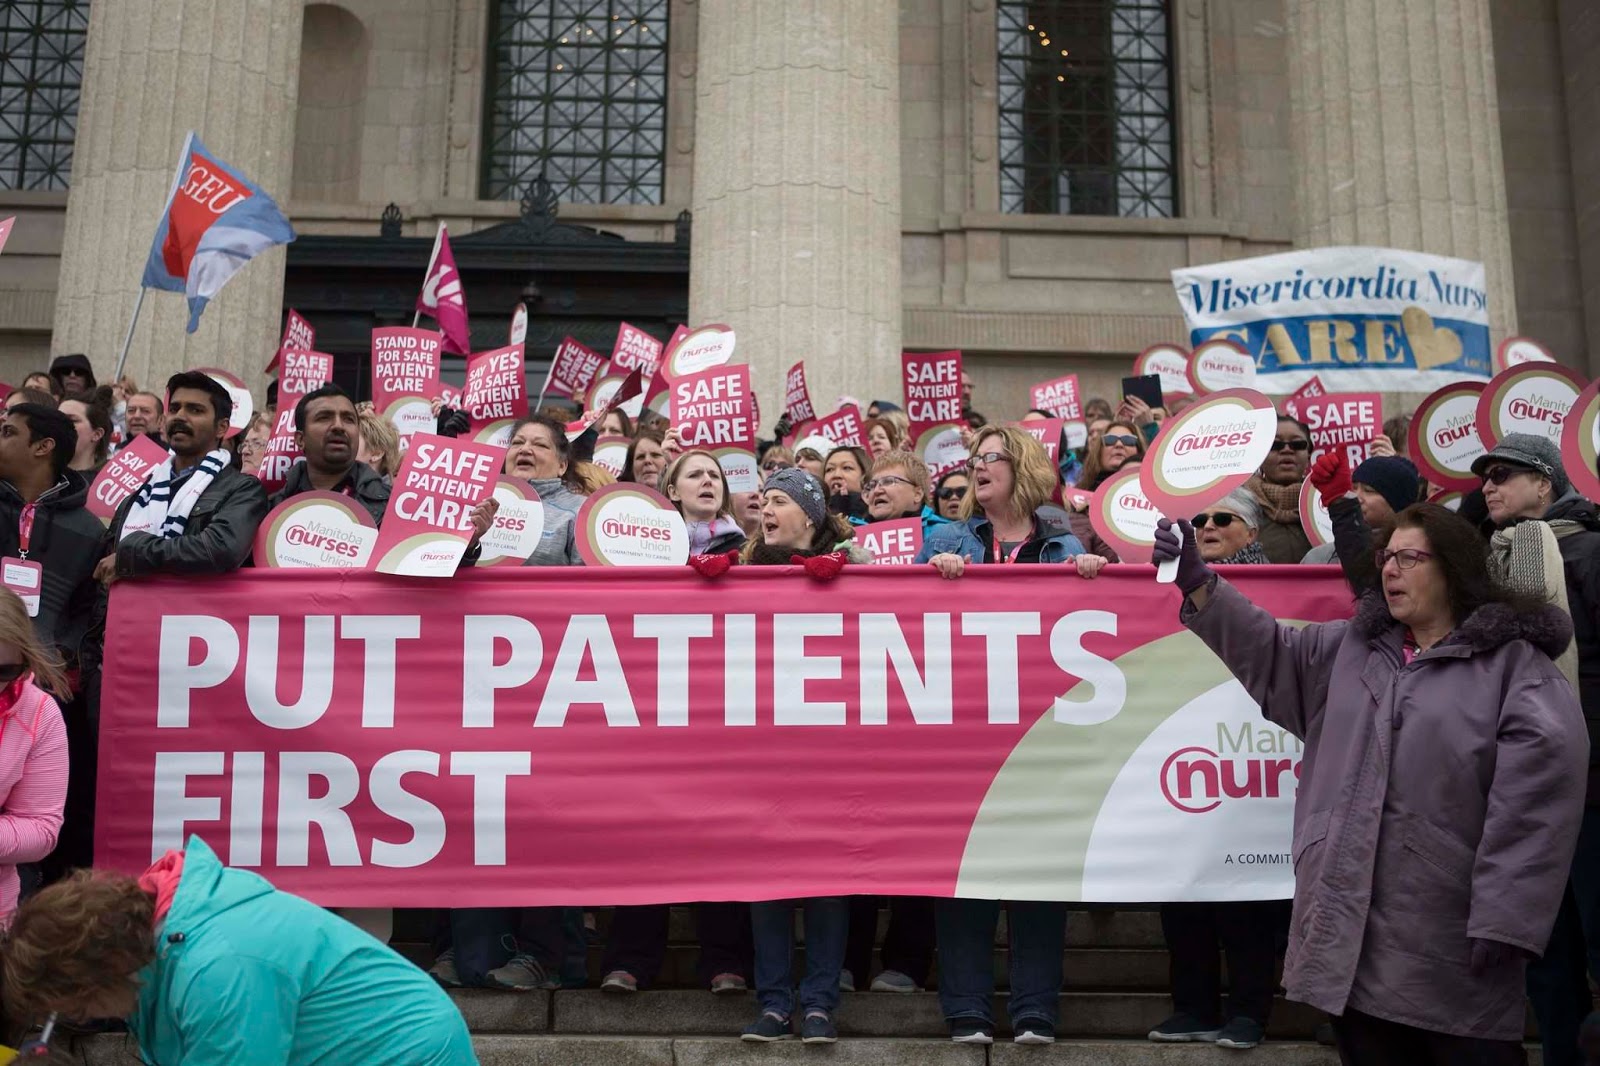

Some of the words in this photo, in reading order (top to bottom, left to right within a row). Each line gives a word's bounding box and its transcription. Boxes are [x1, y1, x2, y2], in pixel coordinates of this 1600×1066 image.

[1190, 266, 1417, 314] Misericordia
[375, 336, 417, 350] STAND
[420, 339, 438, 352] UP
[620, 341, 658, 362] PATIENT
[623, 329, 660, 353] SAFE
[681, 343, 723, 360] nurses
[285, 352, 328, 372] SAFE
[378, 350, 400, 362] FOR
[403, 350, 433, 364] SAFE
[469, 364, 486, 382] SAY
[488, 351, 520, 373] YES
[556, 342, 580, 380] SAFE
[1203, 361, 1244, 374] nurses
[284, 367, 327, 379] PATIENT
[375, 362, 435, 379] PATIENT
[469, 380, 481, 392] TO
[485, 370, 518, 388] SAFE
[907, 360, 958, 383] SAFE
[383, 378, 424, 392] CARE
[677, 374, 743, 405] SAFE
[908, 382, 958, 398] PATIENT
[1034, 380, 1075, 402] SAFE
[464, 384, 521, 408] PATIENT
[1035, 394, 1075, 411] PATIENT
[471, 402, 513, 420] CARE
[678, 400, 742, 421] PATIENT
[908, 398, 960, 422] CARE
[1049, 404, 1081, 421] ARE
[1306, 401, 1374, 430] SAFE
[1512, 400, 1562, 424] nurs
[678, 417, 748, 446] CARE
[1197, 420, 1257, 435] Manitoba
[1311, 425, 1374, 447] PATIENT
[1175, 431, 1253, 454] nurses
[119, 451, 147, 472] SAY
[412, 443, 494, 482] SAFE
[1209, 447, 1246, 460] Union
[107, 461, 123, 477] TO
[724, 467, 750, 476] urses
[405, 471, 484, 502] PATIENT
[394, 491, 477, 531] CARE
[619, 512, 671, 529] Manitoba
[306, 520, 363, 547] Manitoba
[492, 530, 521, 542] Union
[603, 519, 671, 541] nurses
[287, 526, 359, 558] nurses
[640, 540, 672, 552] Union
[851, 527, 915, 556] AFE
[319, 551, 354, 568] Union
[421, 552, 455, 562] nurses
[156, 614, 421, 729] PUT
[461, 609, 1127, 729] PATIENTS
[151, 748, 532, 869] FIRST
[1224, 854, 1234, 864] A
[1238, 853, 1293, 865] COMMIT
